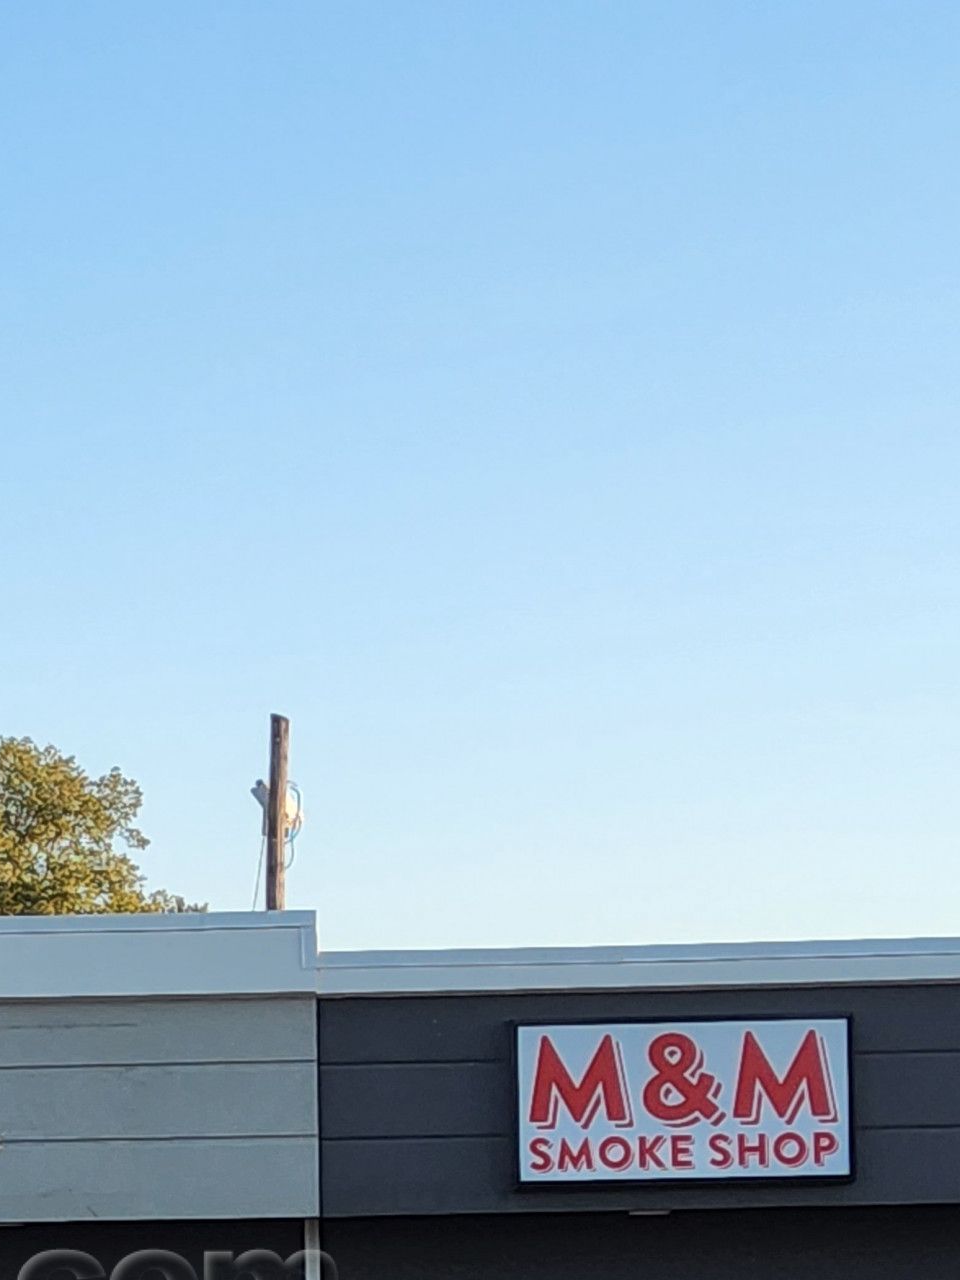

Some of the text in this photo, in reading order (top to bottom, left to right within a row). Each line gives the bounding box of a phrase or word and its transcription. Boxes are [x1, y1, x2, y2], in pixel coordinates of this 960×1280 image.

[529, 1029, 838, 1130] M&M
[528, 1131, 839, 1173] SMOKE SHOP
